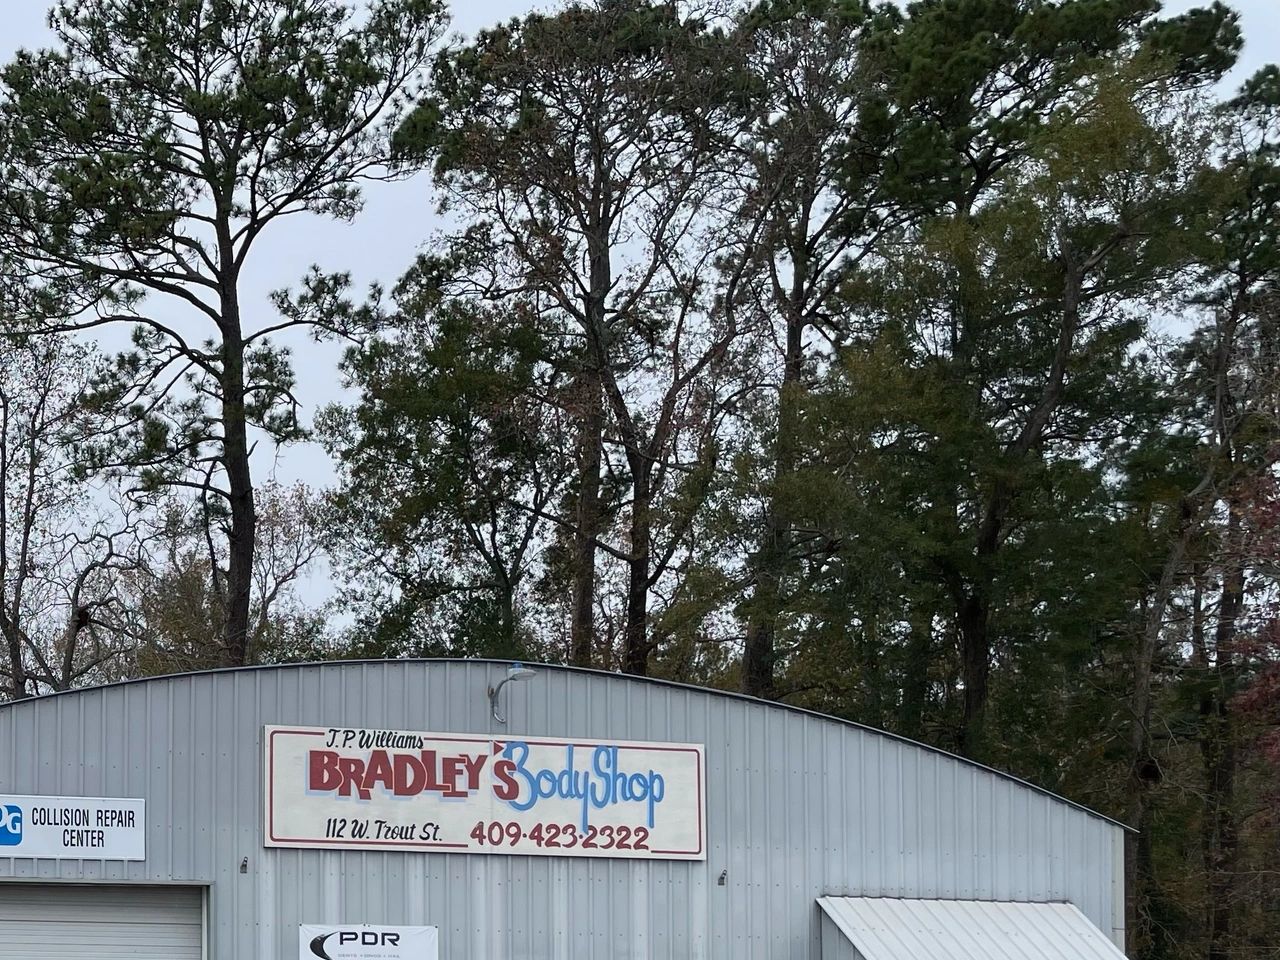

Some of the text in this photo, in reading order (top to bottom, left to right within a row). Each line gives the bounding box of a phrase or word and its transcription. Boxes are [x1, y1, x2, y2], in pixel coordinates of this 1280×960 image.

[326, 728, 424, 750] J.P. Williams
[308, 741, 520, 801] BRADLEY'S
[502, 740, 665, 835] Body Shop
[31, 807, 136, 828] COLLISION REPAIR
[62, 828, 105, 848] CENTER
[325, 817, 443, 842] 112 W. Trout St.
[339, 931, 401, 947] PDR
